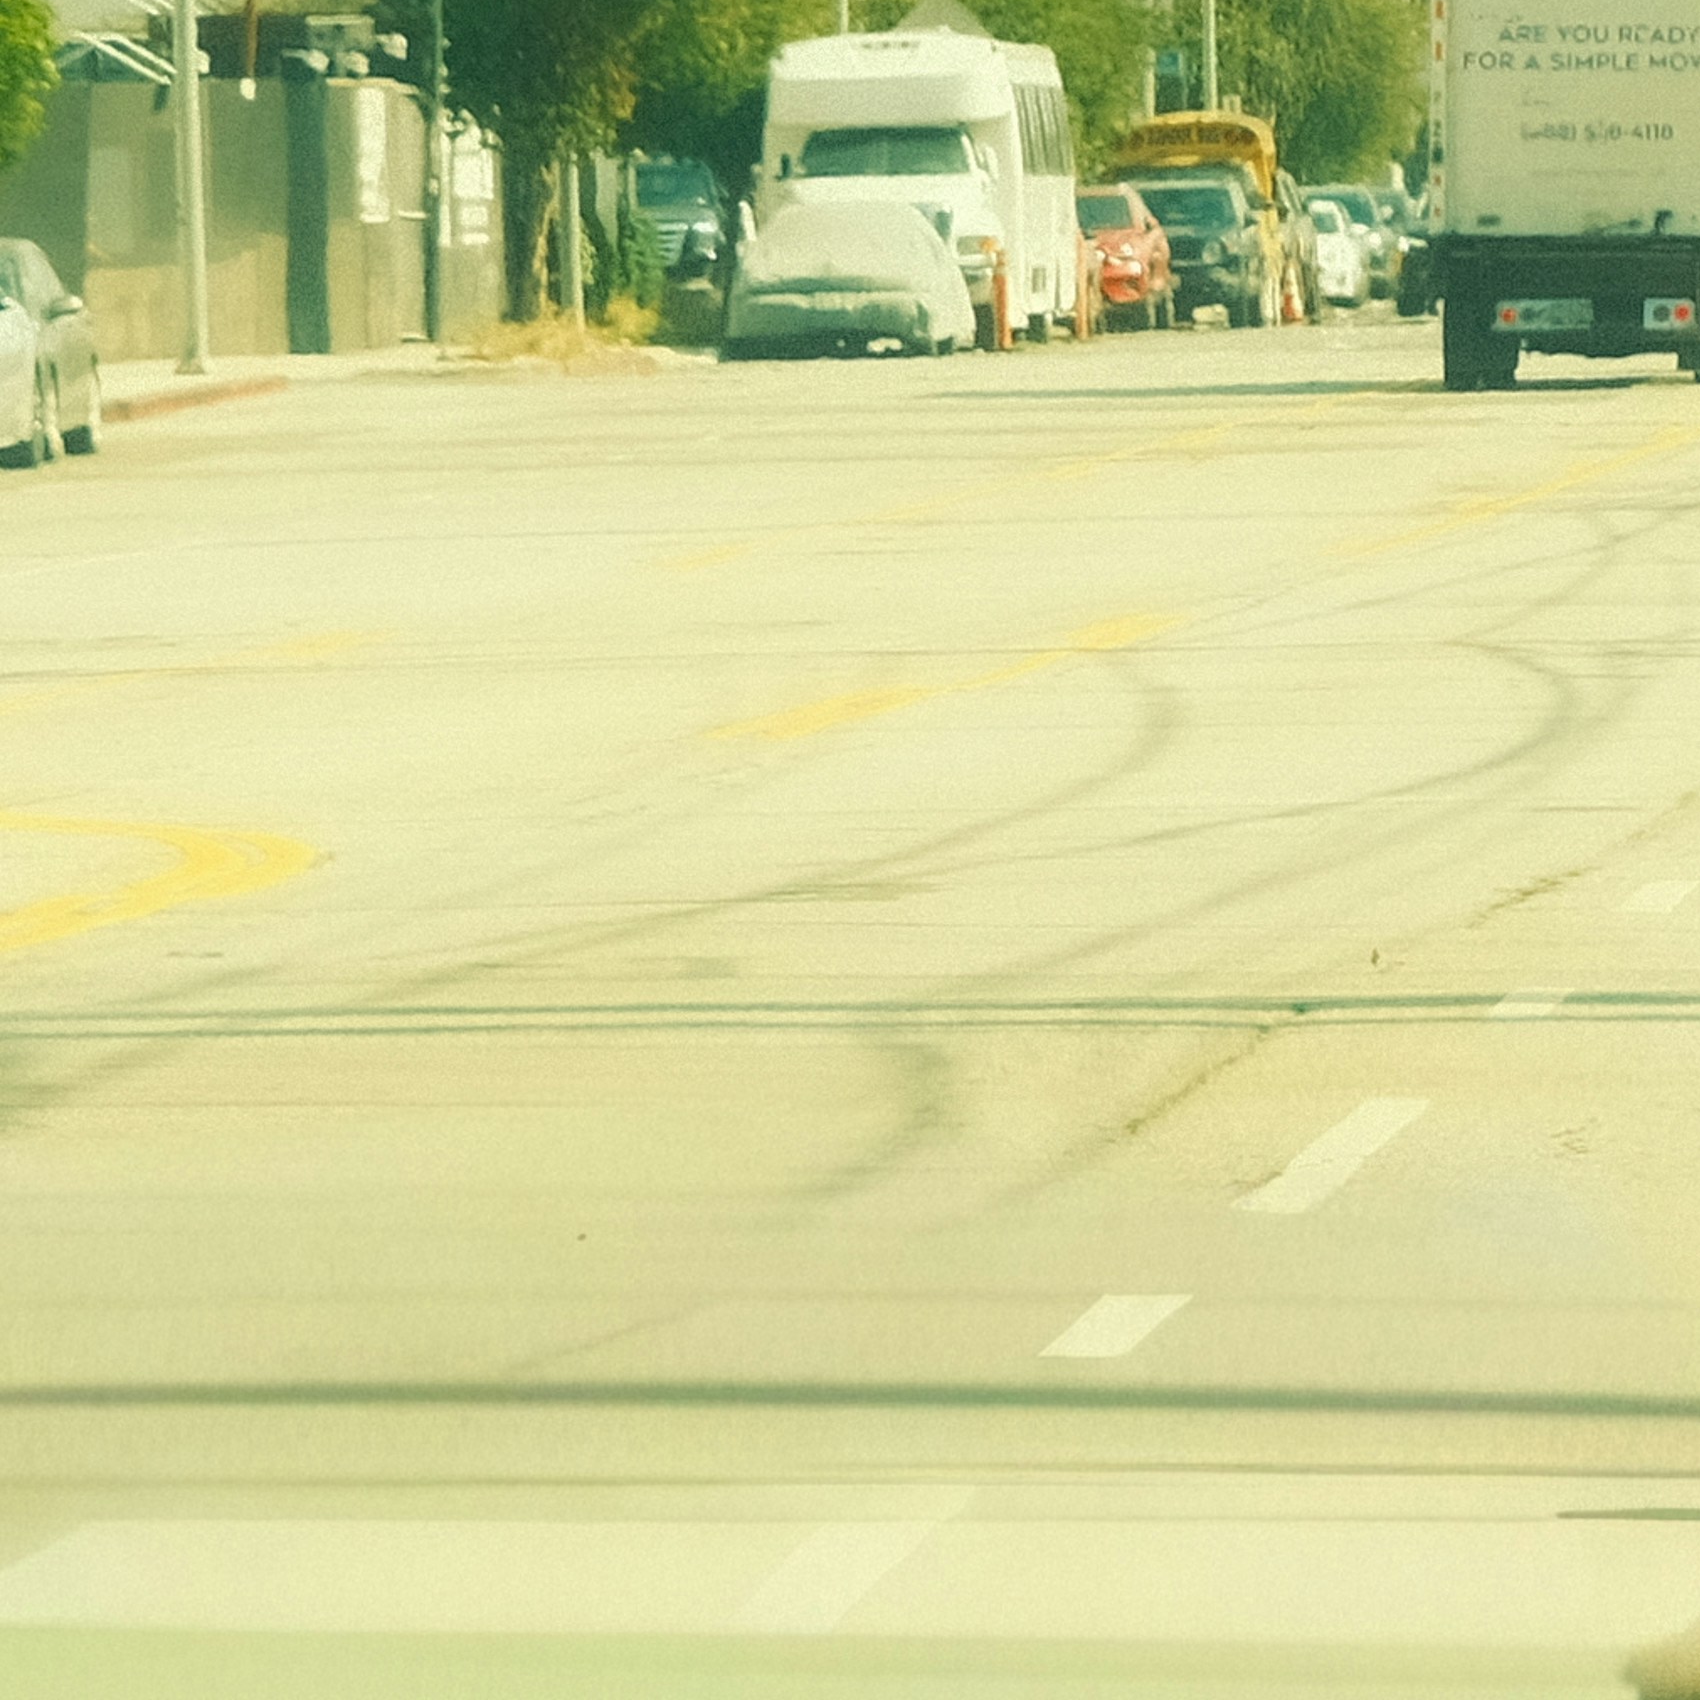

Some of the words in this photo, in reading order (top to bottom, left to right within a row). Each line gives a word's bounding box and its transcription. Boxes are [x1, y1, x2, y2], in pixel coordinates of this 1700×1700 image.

[1498, 24, 1547, 44] ARE
[1557, 24, 1609, 44] YOU
[1462, 51, 1516, 71] FOR
[1523, 53, 1542, 71] A
[1550, 52, 1641, 72] SIMPLE
